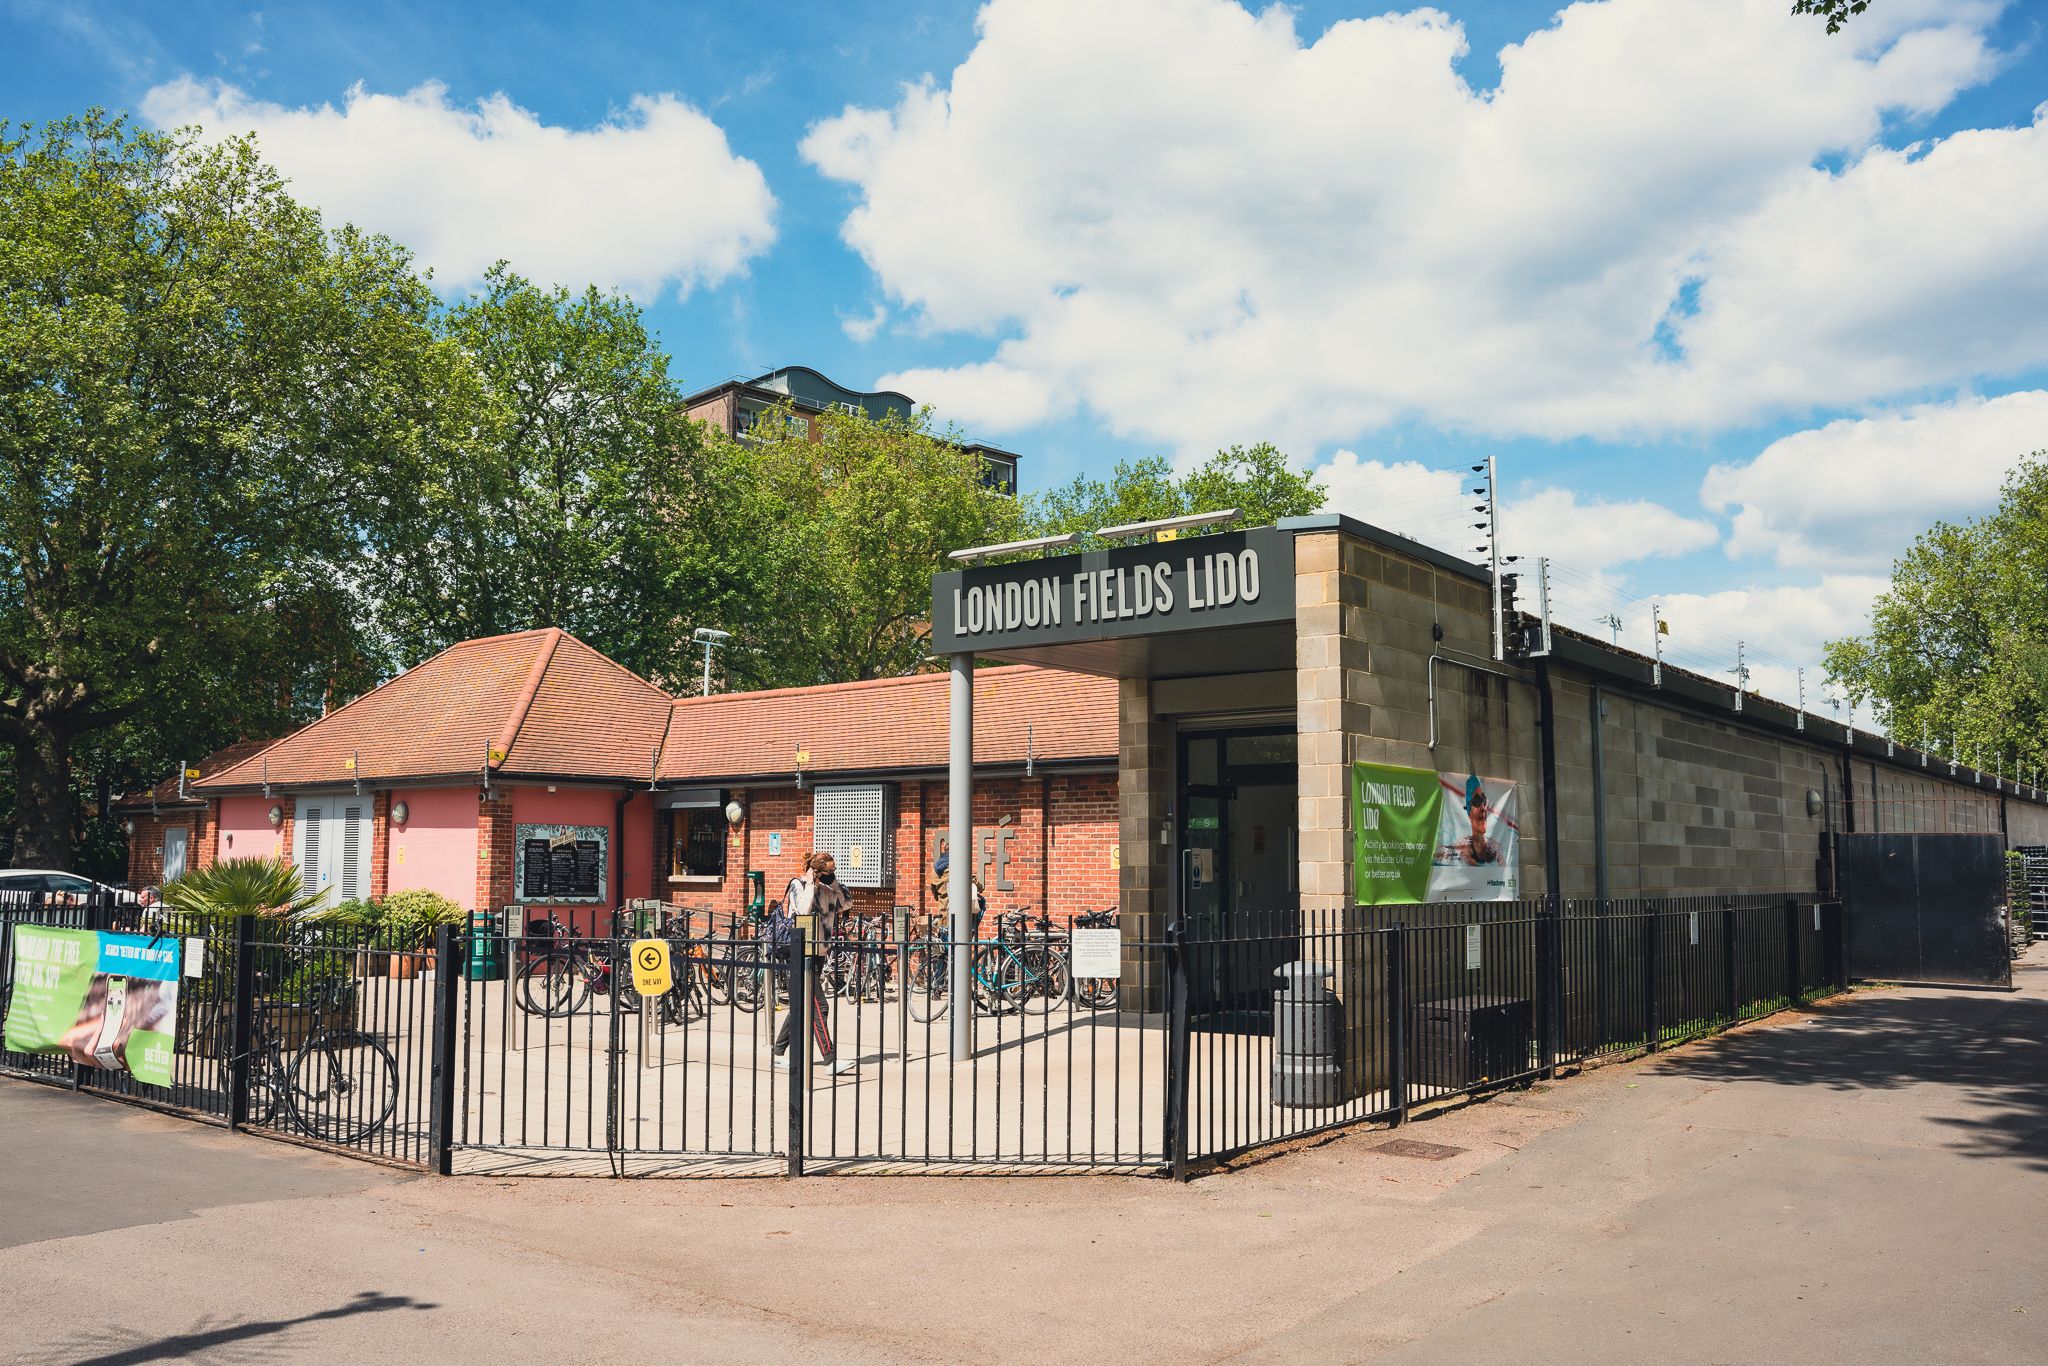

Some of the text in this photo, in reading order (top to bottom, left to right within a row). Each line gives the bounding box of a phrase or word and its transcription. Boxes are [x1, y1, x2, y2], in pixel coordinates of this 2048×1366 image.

[954, 548, 1260, 635] LONDON FIELDS LIDO
[1361, 781, 1416, 807] LONDON FIELDS
[1362, 807, 1380, 830] LIDO
[933, 814, 1015, 891] CFÉ
[1364, 838, 1427, 853] Activity bookings now open
[1364, 854, 1373, 864] via
[1380, 853, 1395, 864] Better
[1396, 854, 1405, 864] UK
[1404, 856, 1415, 867] app
[1364, 870, 1371, 879] or
[50, 938, 65, 963] THE
[64, 939, 81, 966] FREE
[32, 962, 44, 988] UK
[45, 965, 61, 991] APP
[642, 977, 662, 986] ONE WAY
[144, 1048, 170, 1066] BETTER
